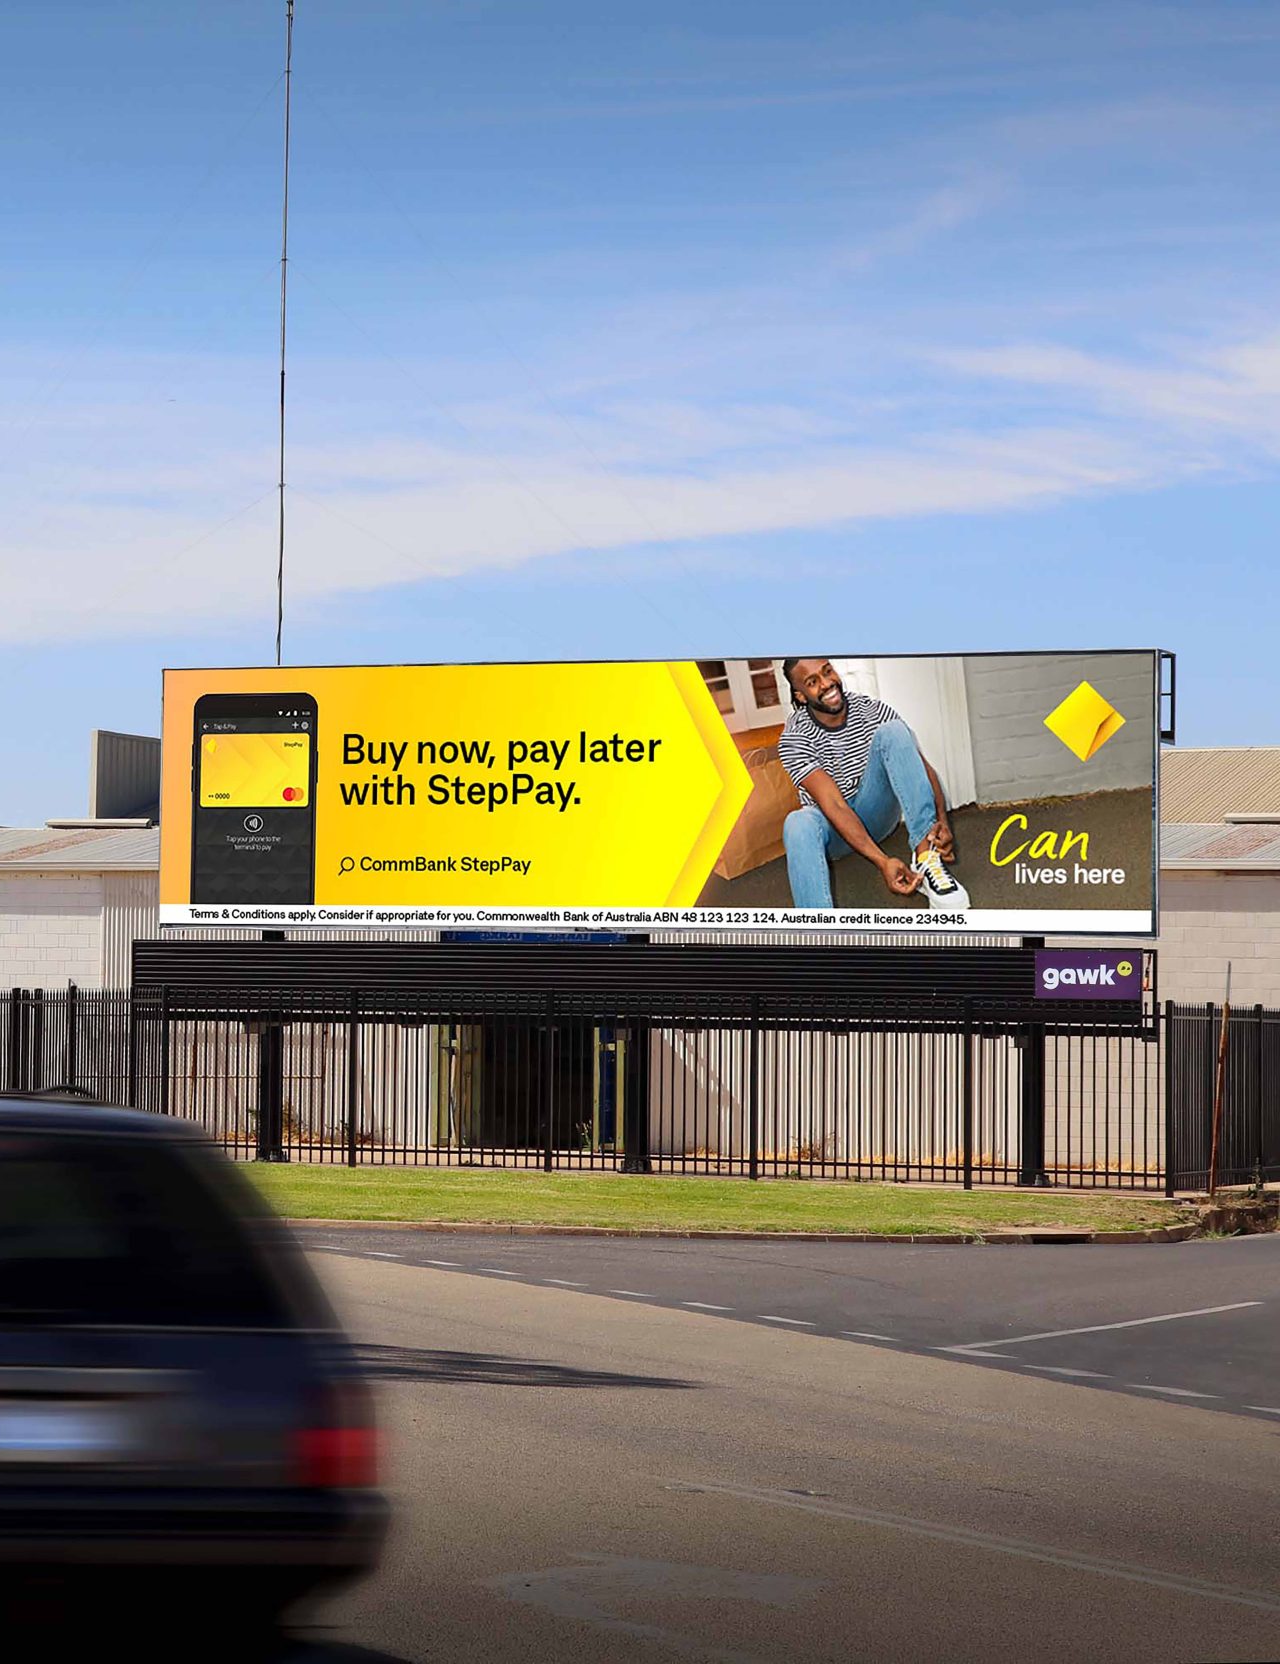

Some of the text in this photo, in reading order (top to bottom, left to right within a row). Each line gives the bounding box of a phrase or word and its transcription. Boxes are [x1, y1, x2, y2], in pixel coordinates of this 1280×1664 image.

[342, 731, 662, 771] Buy now, pay later
[339, 773, 581, 813] with StepPay.
[990, 813, 1089, 867] Can
[360, 856, 532, 876] CommBank StepPay
[1015, 863, 1125, 884] lives here
[189, 908, 967, 925] Terms & Conditions apply. Consider if appropriate for you. Commonwealth Bank of Australia ABN 48 123 123 124. Australian credit licence 234945.
[1042, 964, 1116, 990] gawk
